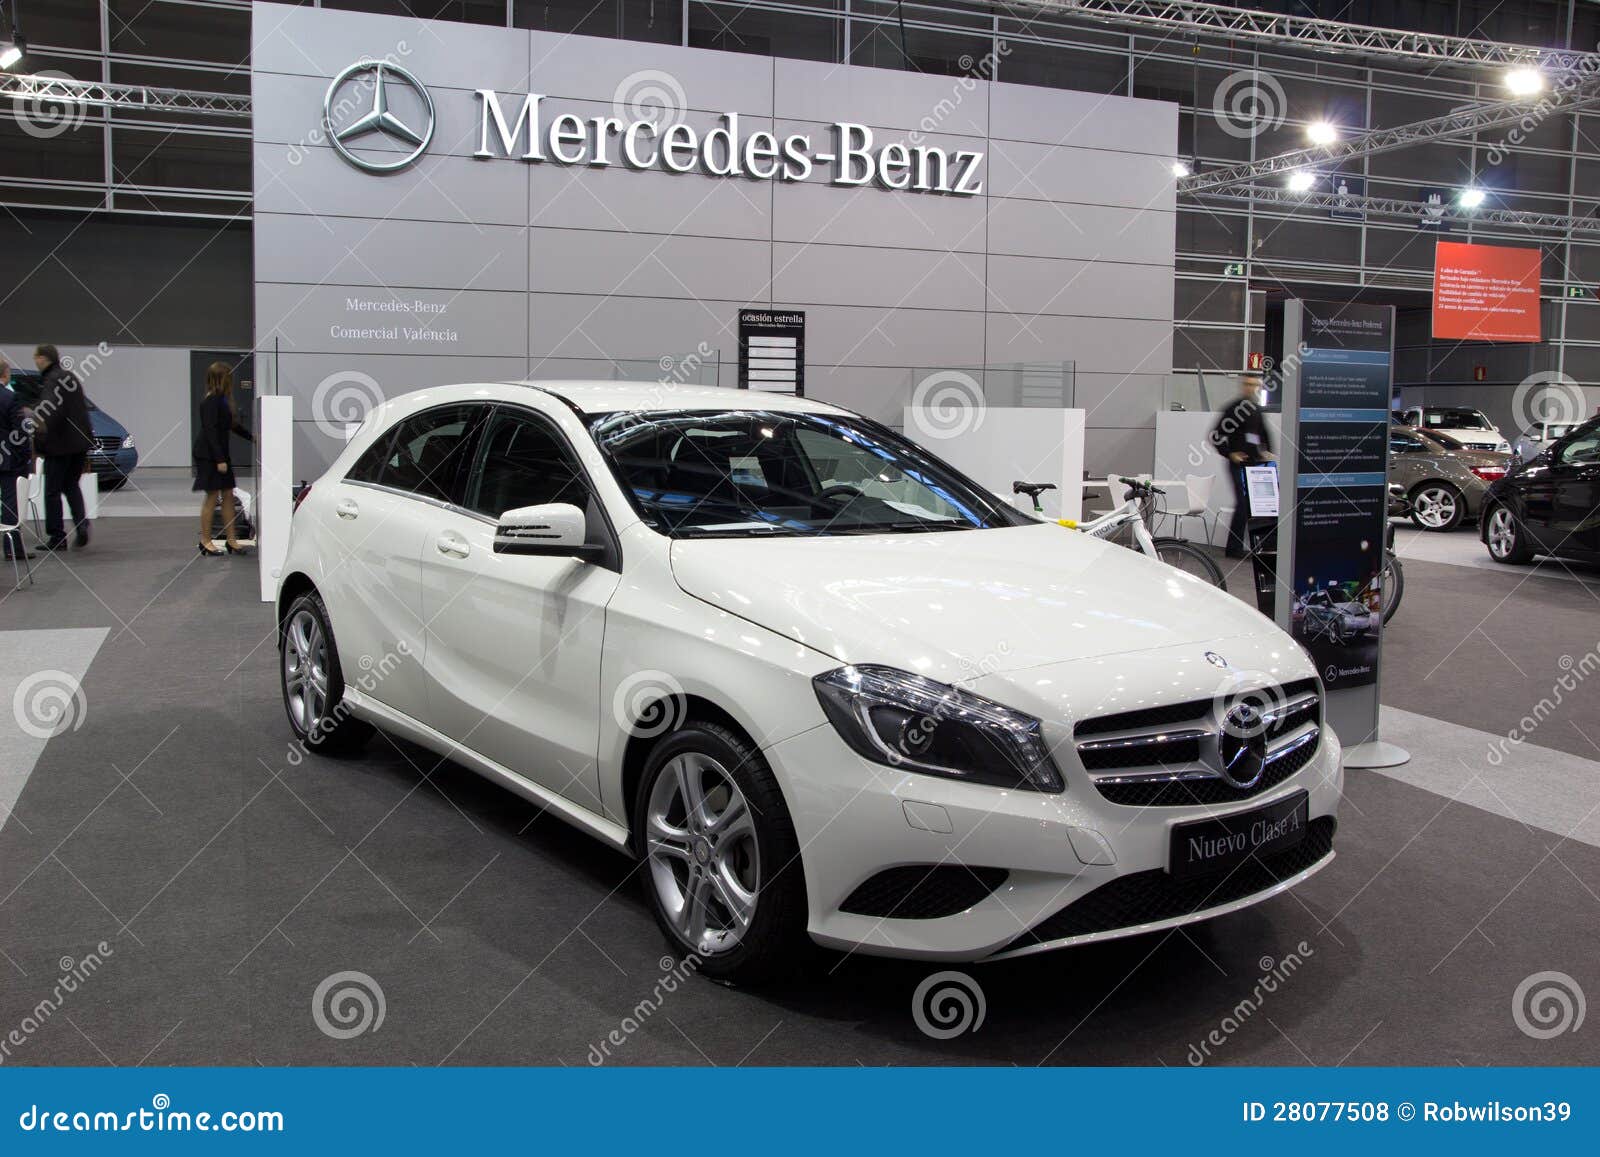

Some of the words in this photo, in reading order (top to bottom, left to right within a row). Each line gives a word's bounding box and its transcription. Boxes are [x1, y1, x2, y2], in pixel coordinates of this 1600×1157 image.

[474, 88, 984, 196] Mercedes-Benz
[345, 298, 447, 313] Mercedes-Benz
[742, 313, 772, 323] ocasión
[774, 314, 803, 324] estrella
[330, 325, 398, 340] Comercial
[403, 327, 458, 342] Valencia
[1187, 832, 1246, 863] Nuevo
[1250, 818, 1288, 847] Clase
